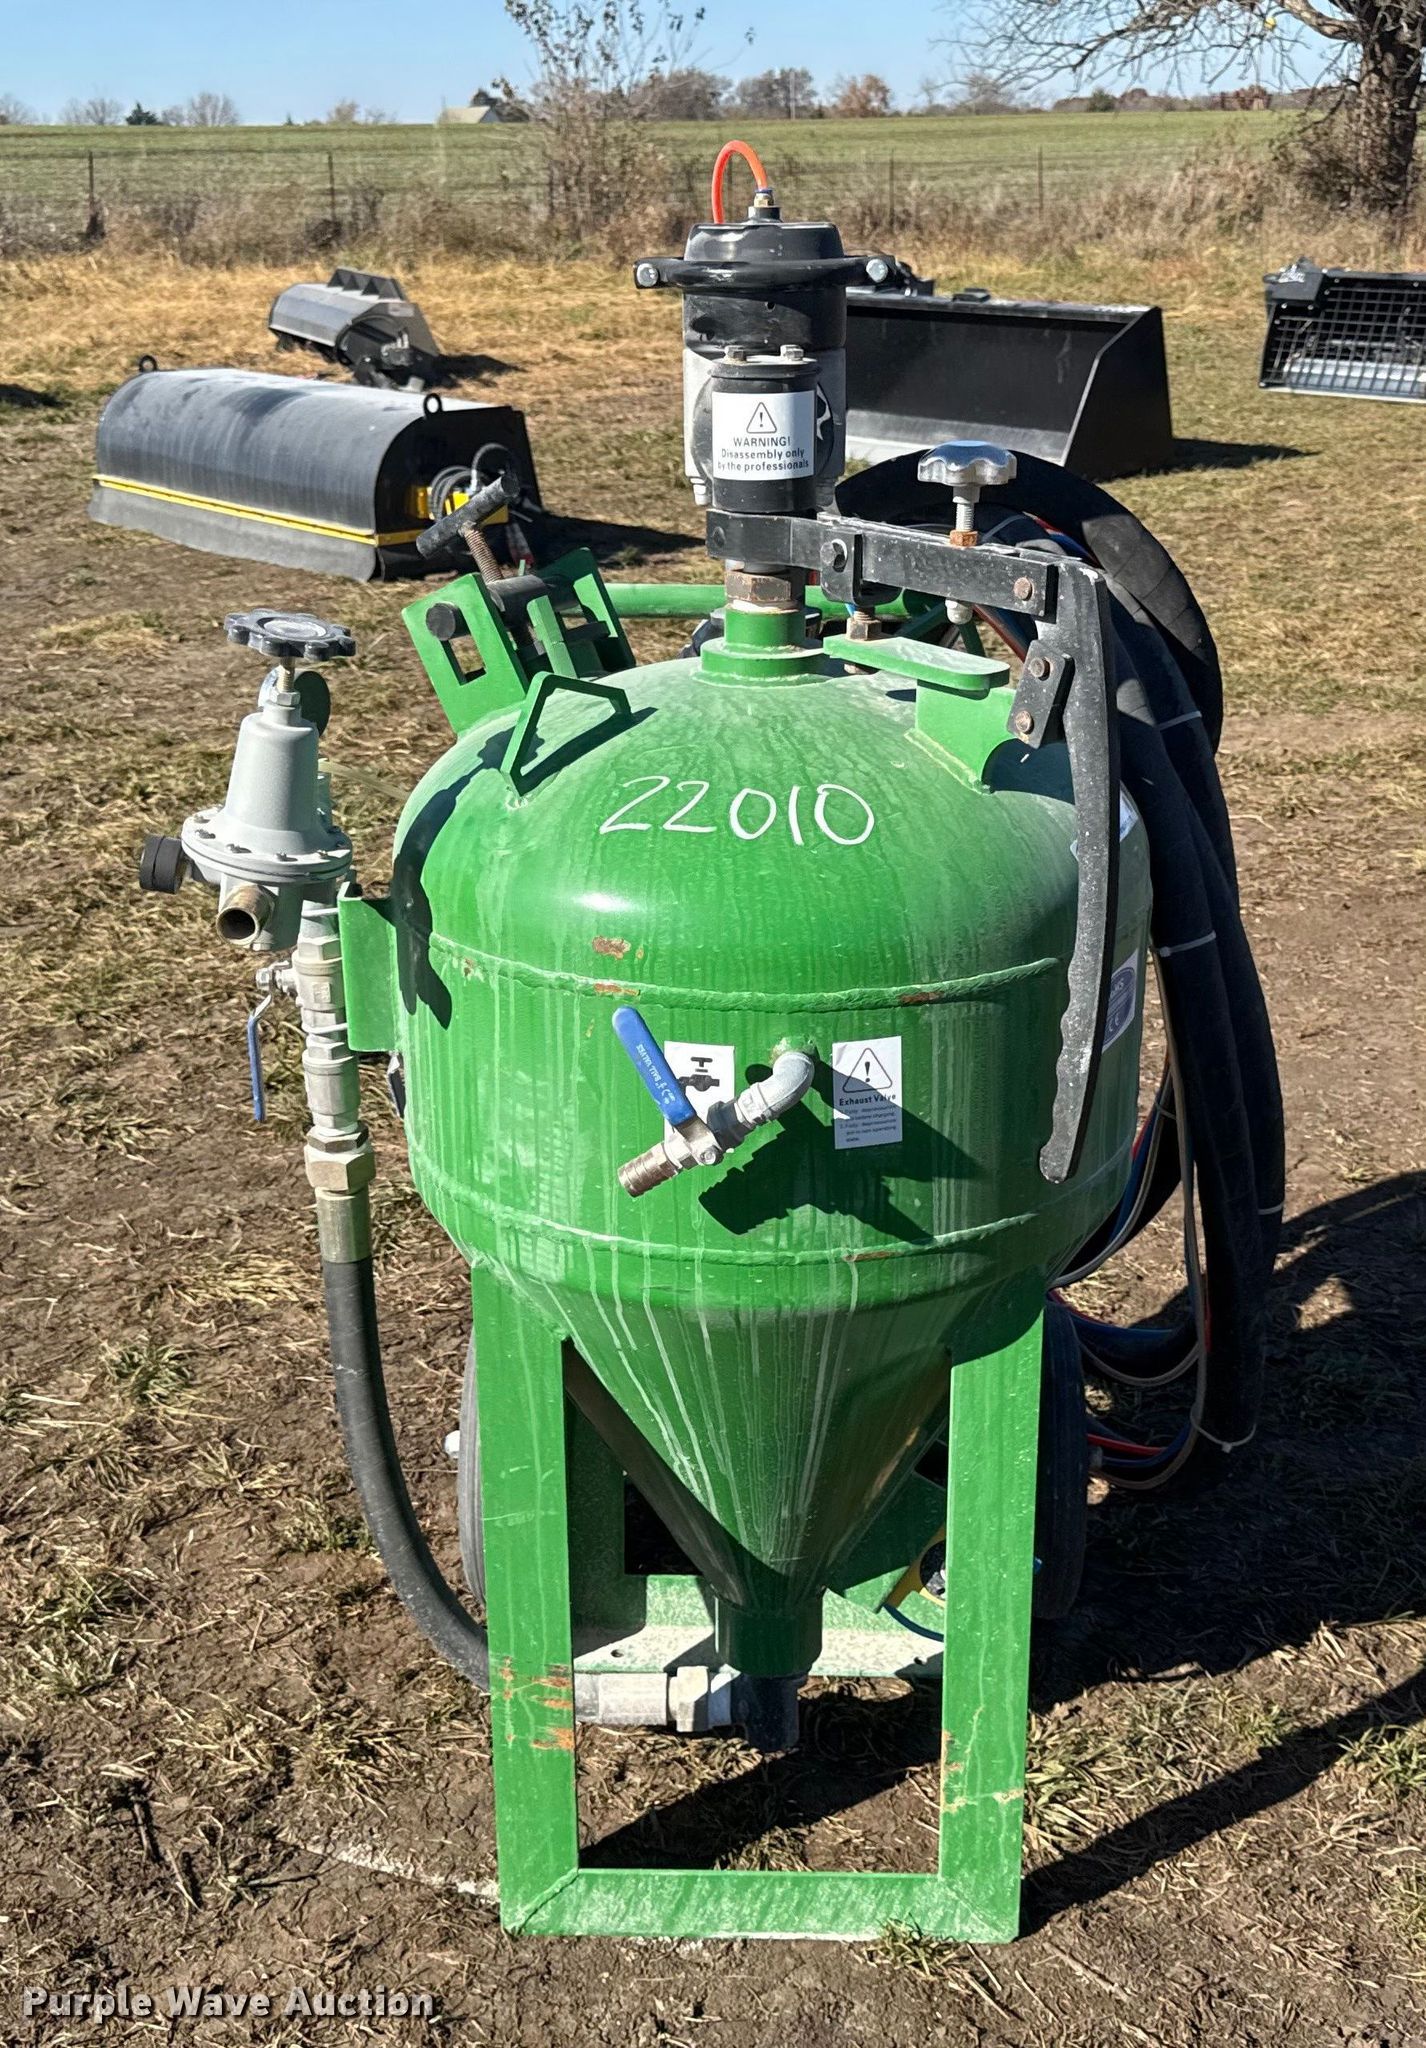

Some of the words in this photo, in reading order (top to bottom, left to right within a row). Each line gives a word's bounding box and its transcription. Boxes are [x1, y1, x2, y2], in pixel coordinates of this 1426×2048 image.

[733, 436, 791, 447] WARNING!
[721, 448, 783, 460] Disassembly
[785, 448, 805, 459] only
[727, 462, 741, 471] the
[744, 459, 809, 473] professionals
[600, 775, 875, 846] 22010
[649, 1065, 662, 1082] BALL
[839, 1097, 872, 1106] Exhaust
[873, 1093, 896, 1102] Valve
